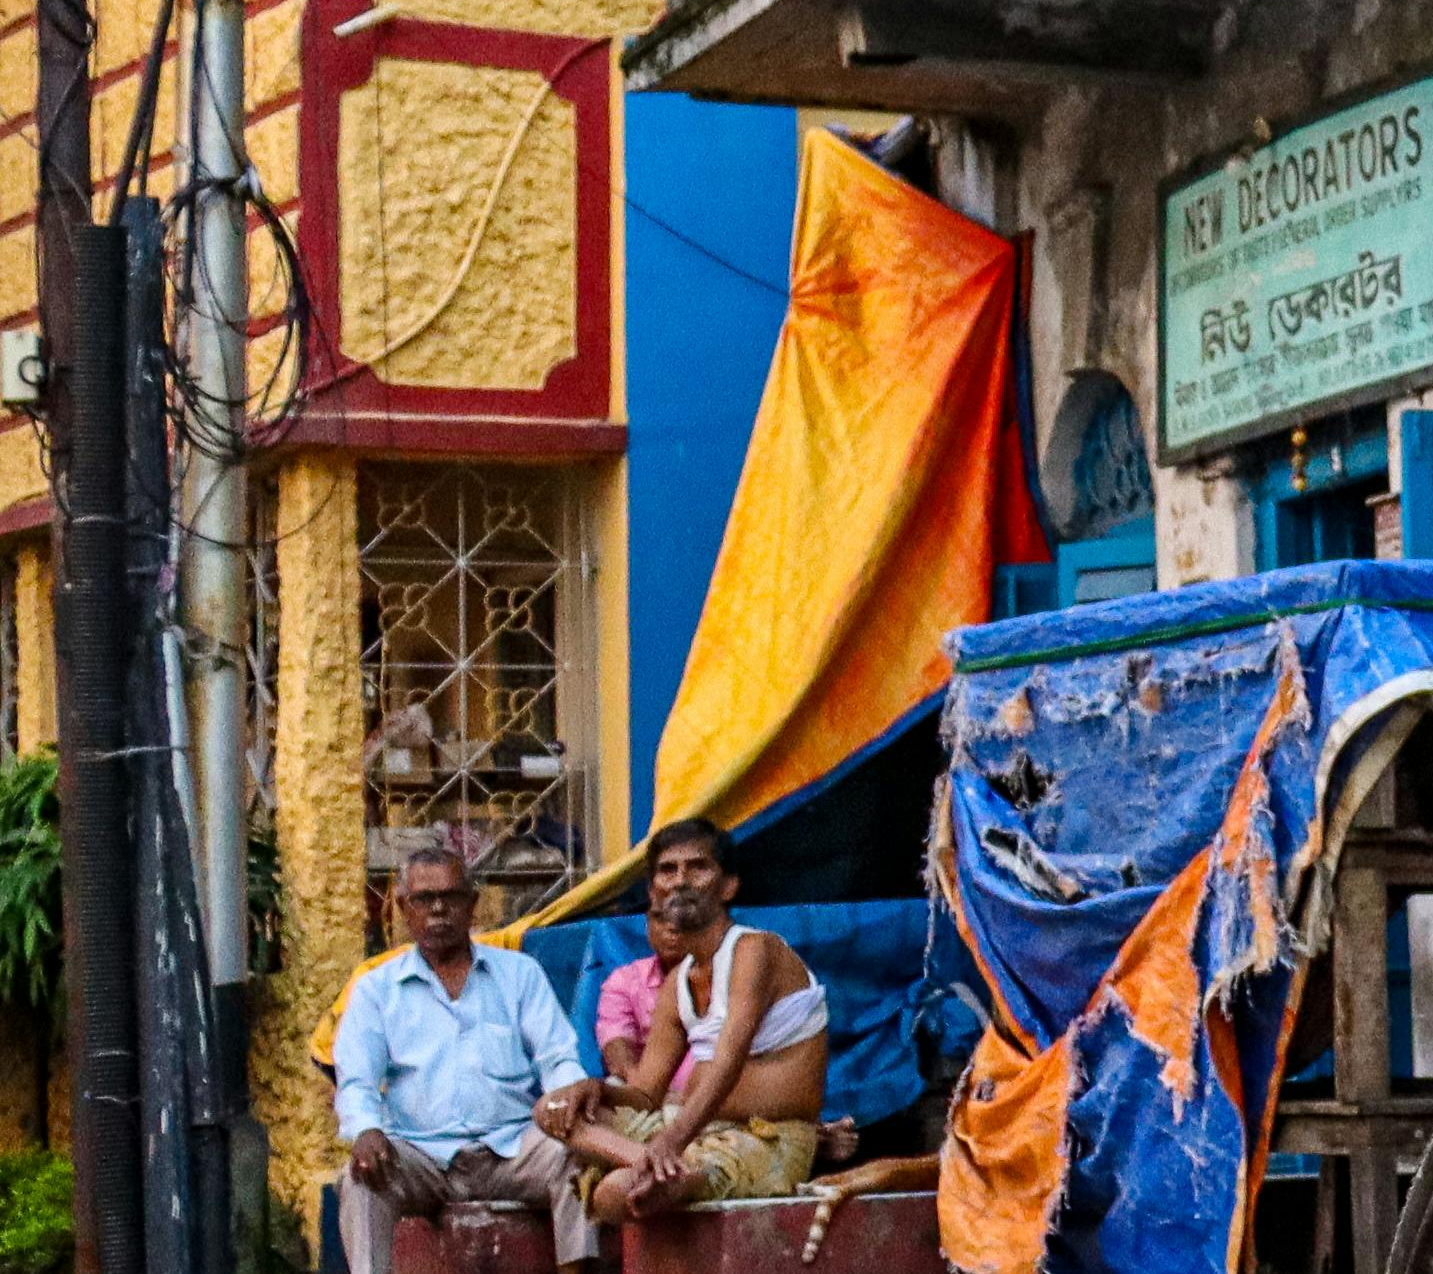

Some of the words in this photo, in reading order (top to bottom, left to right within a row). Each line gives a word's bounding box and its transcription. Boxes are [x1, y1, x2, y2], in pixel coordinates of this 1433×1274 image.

[1183, 188, 1225, 255] NEW
[1238, 106, 1423, 234] DECORATORS
[1201, 300, 1251, 364] নিউ
